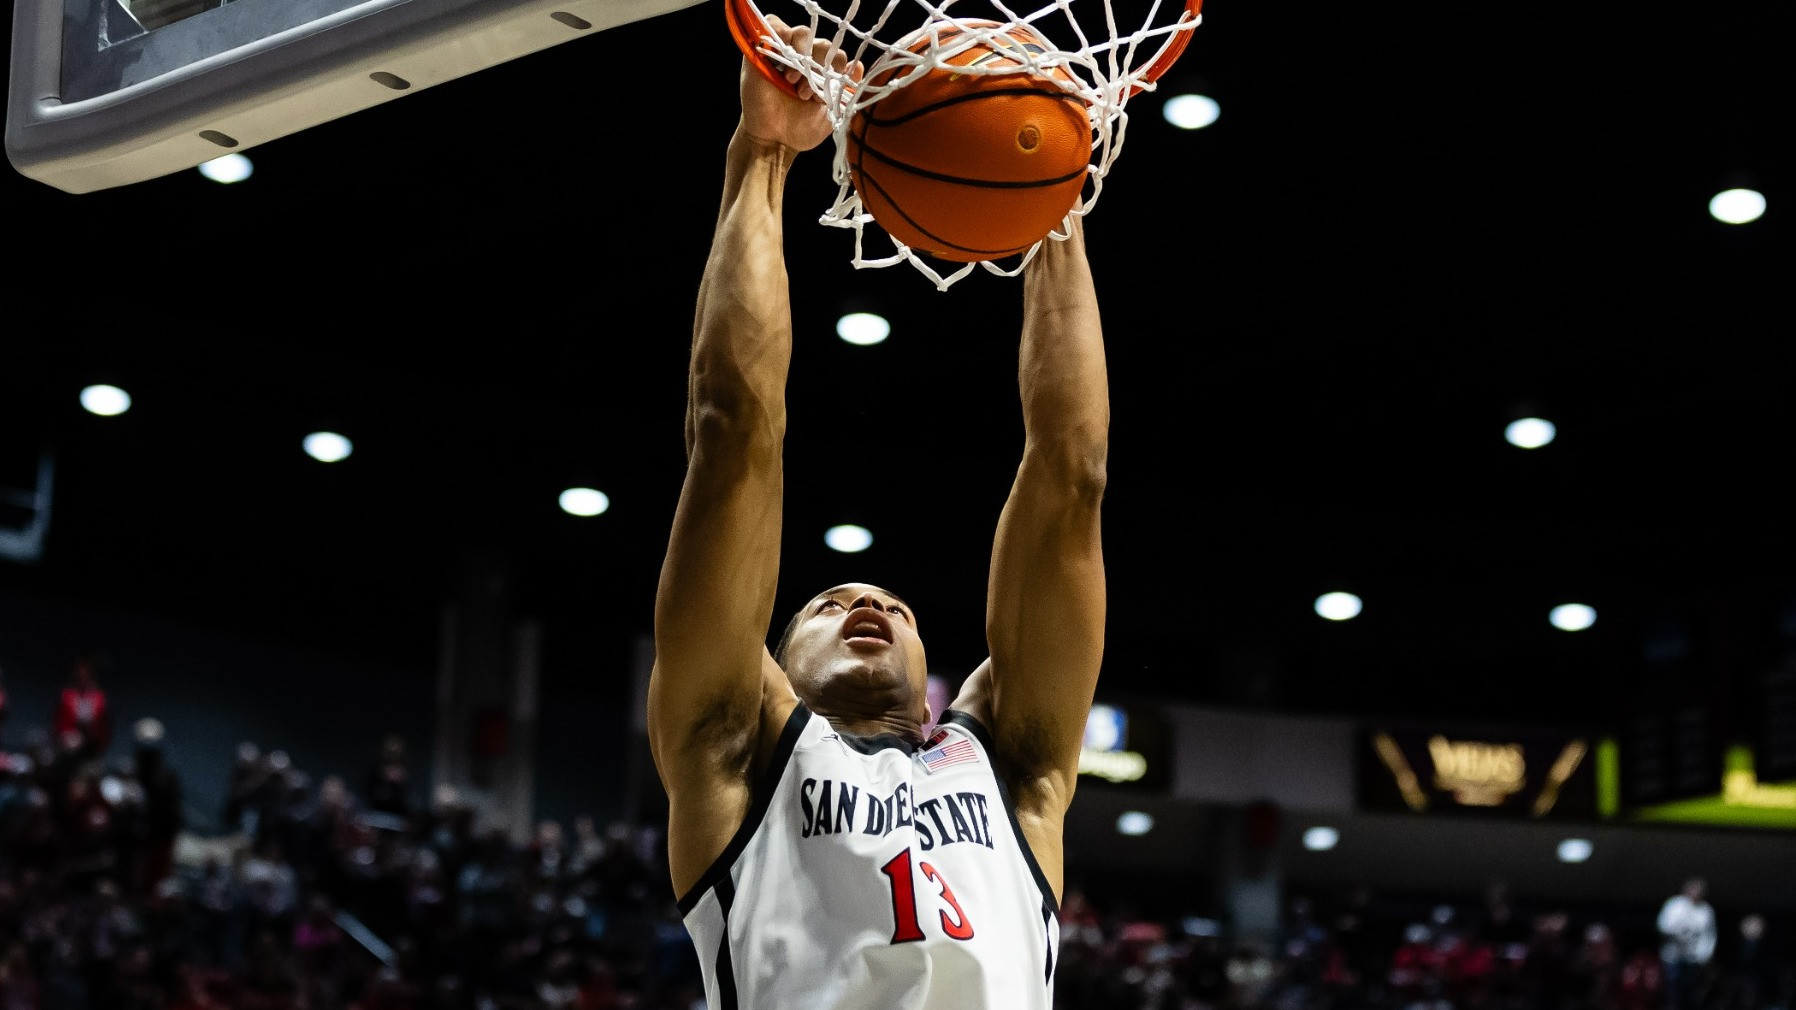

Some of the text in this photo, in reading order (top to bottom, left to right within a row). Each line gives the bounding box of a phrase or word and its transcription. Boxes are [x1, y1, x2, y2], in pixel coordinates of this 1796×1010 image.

[800, 777, 859, 839] SAN
[863, 781, 914, 838] DIE
[880, 846, 975, 945] 13
